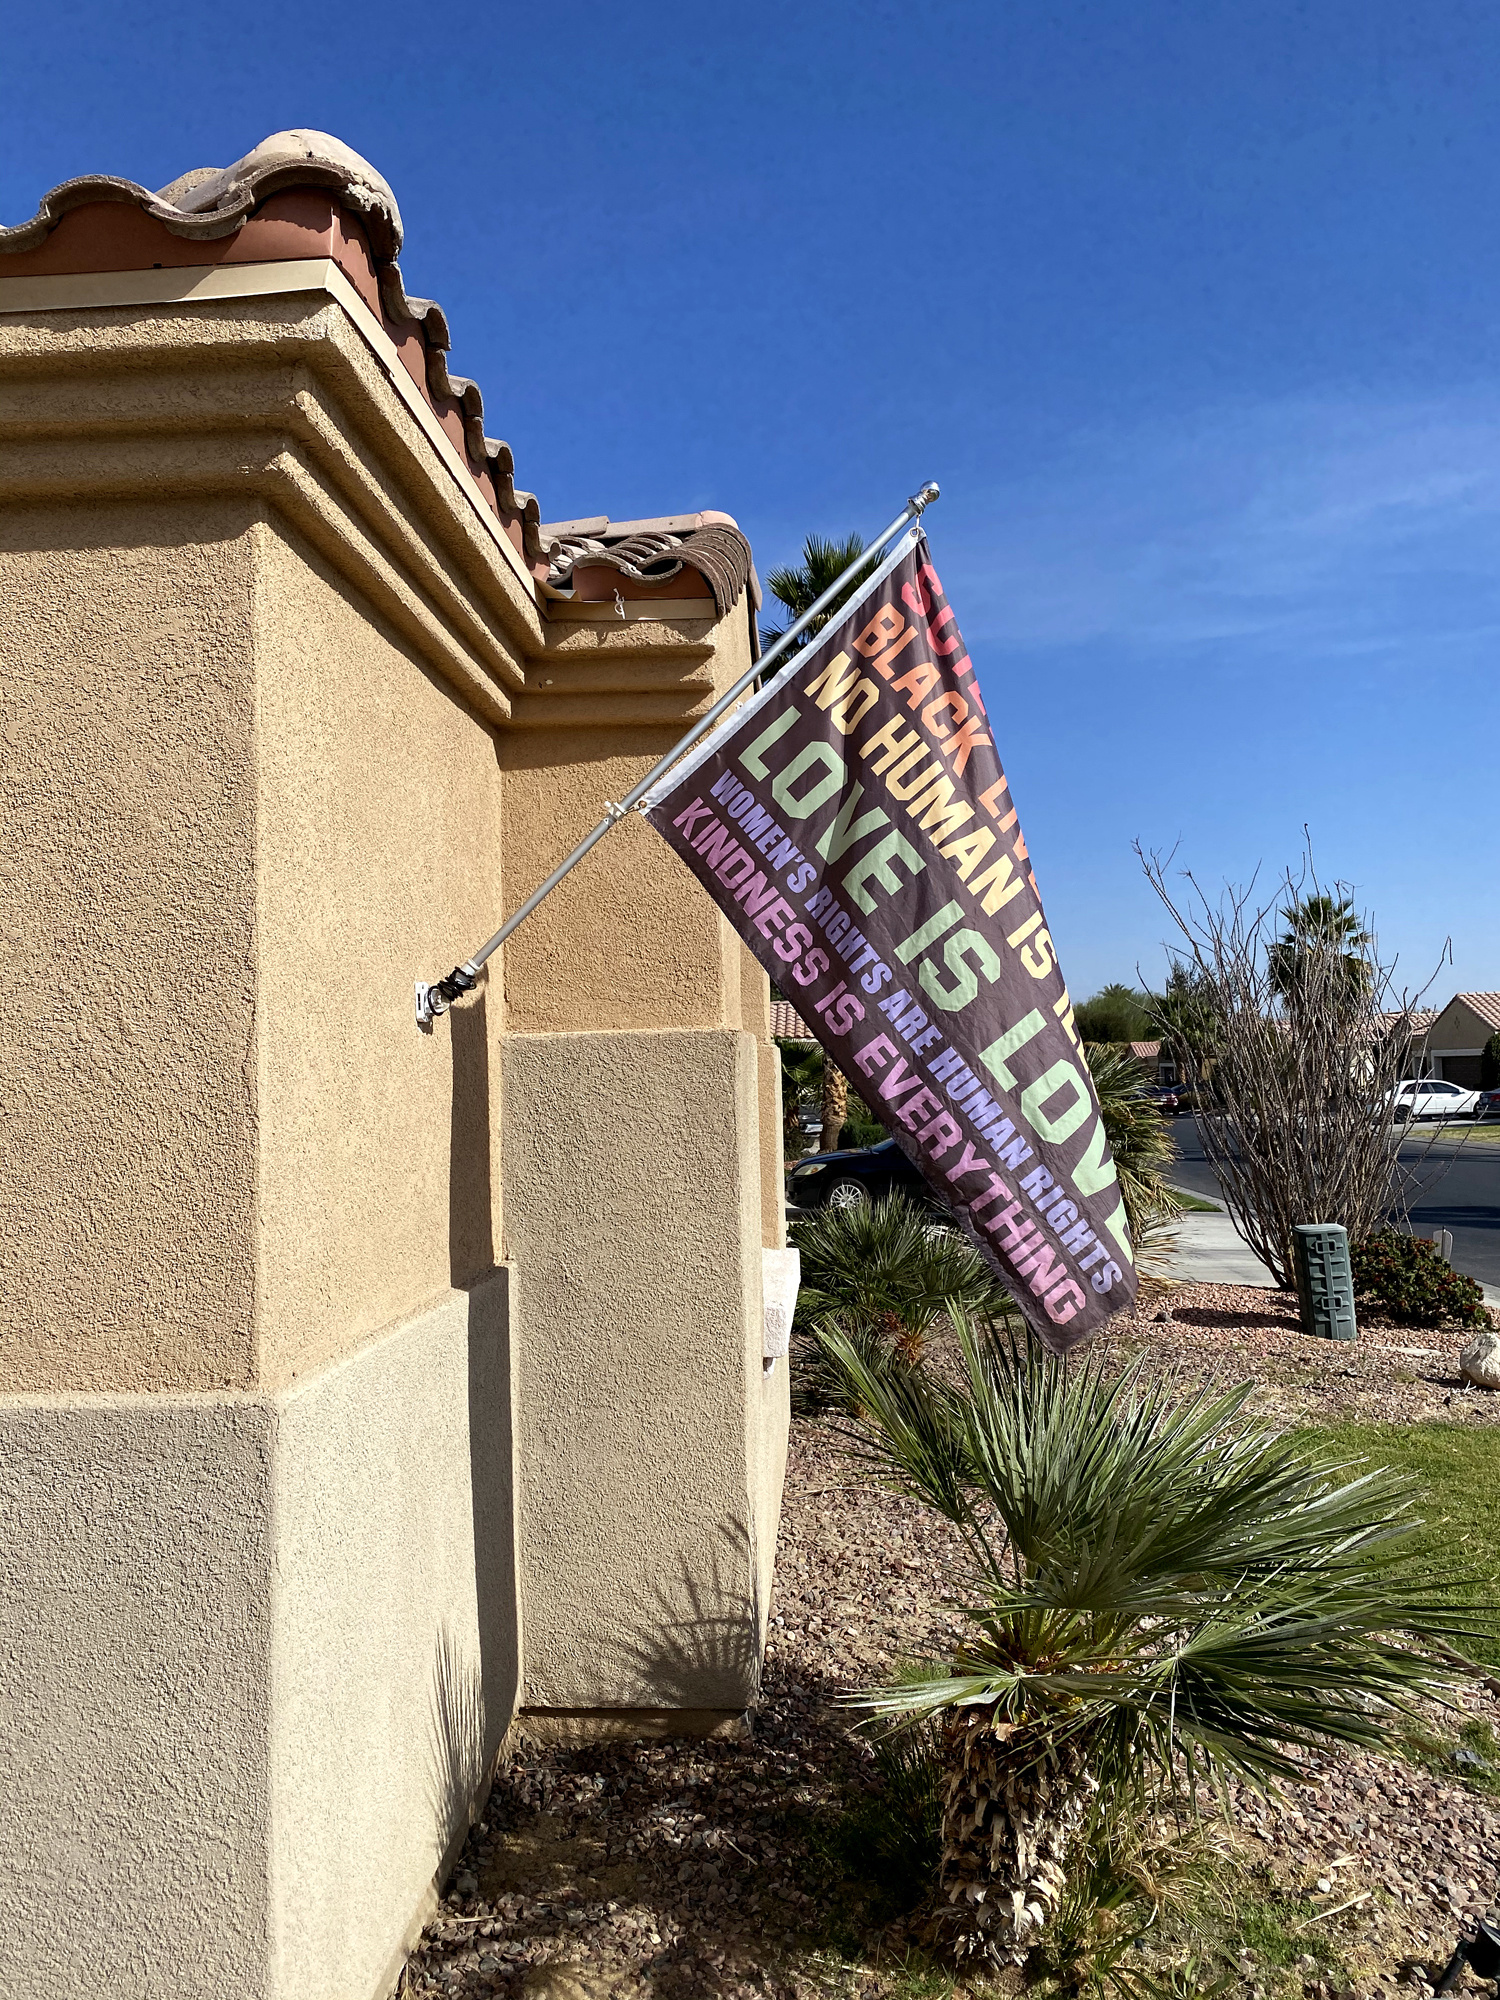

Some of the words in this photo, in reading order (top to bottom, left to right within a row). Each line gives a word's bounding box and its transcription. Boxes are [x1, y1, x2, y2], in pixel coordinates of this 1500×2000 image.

[803, 650, 880, 736] NO
[859, 712, 1025, 917] HUMAN
[1006, 910, 1057, 980] IS
[852, 602, 992, 777] BLACK
[738, 705, 926, 916] LOVE
[893, 899, 1001, 1012] IS
[673, 797, 830, 987] KINDNESS
[814, 980, 866, 1037] IS
[853, 1033, 1087, 1324] EVERYTHING
[710, 769, 818, 894] WOMEN'S
[804, 885, 893, 994] RIGHTS
[877, 988, 943, 1056] ARE
[927, 1046, 1034, 1172] HUMAN
[1018, 1162, 1123, 1295] RIGHTS
